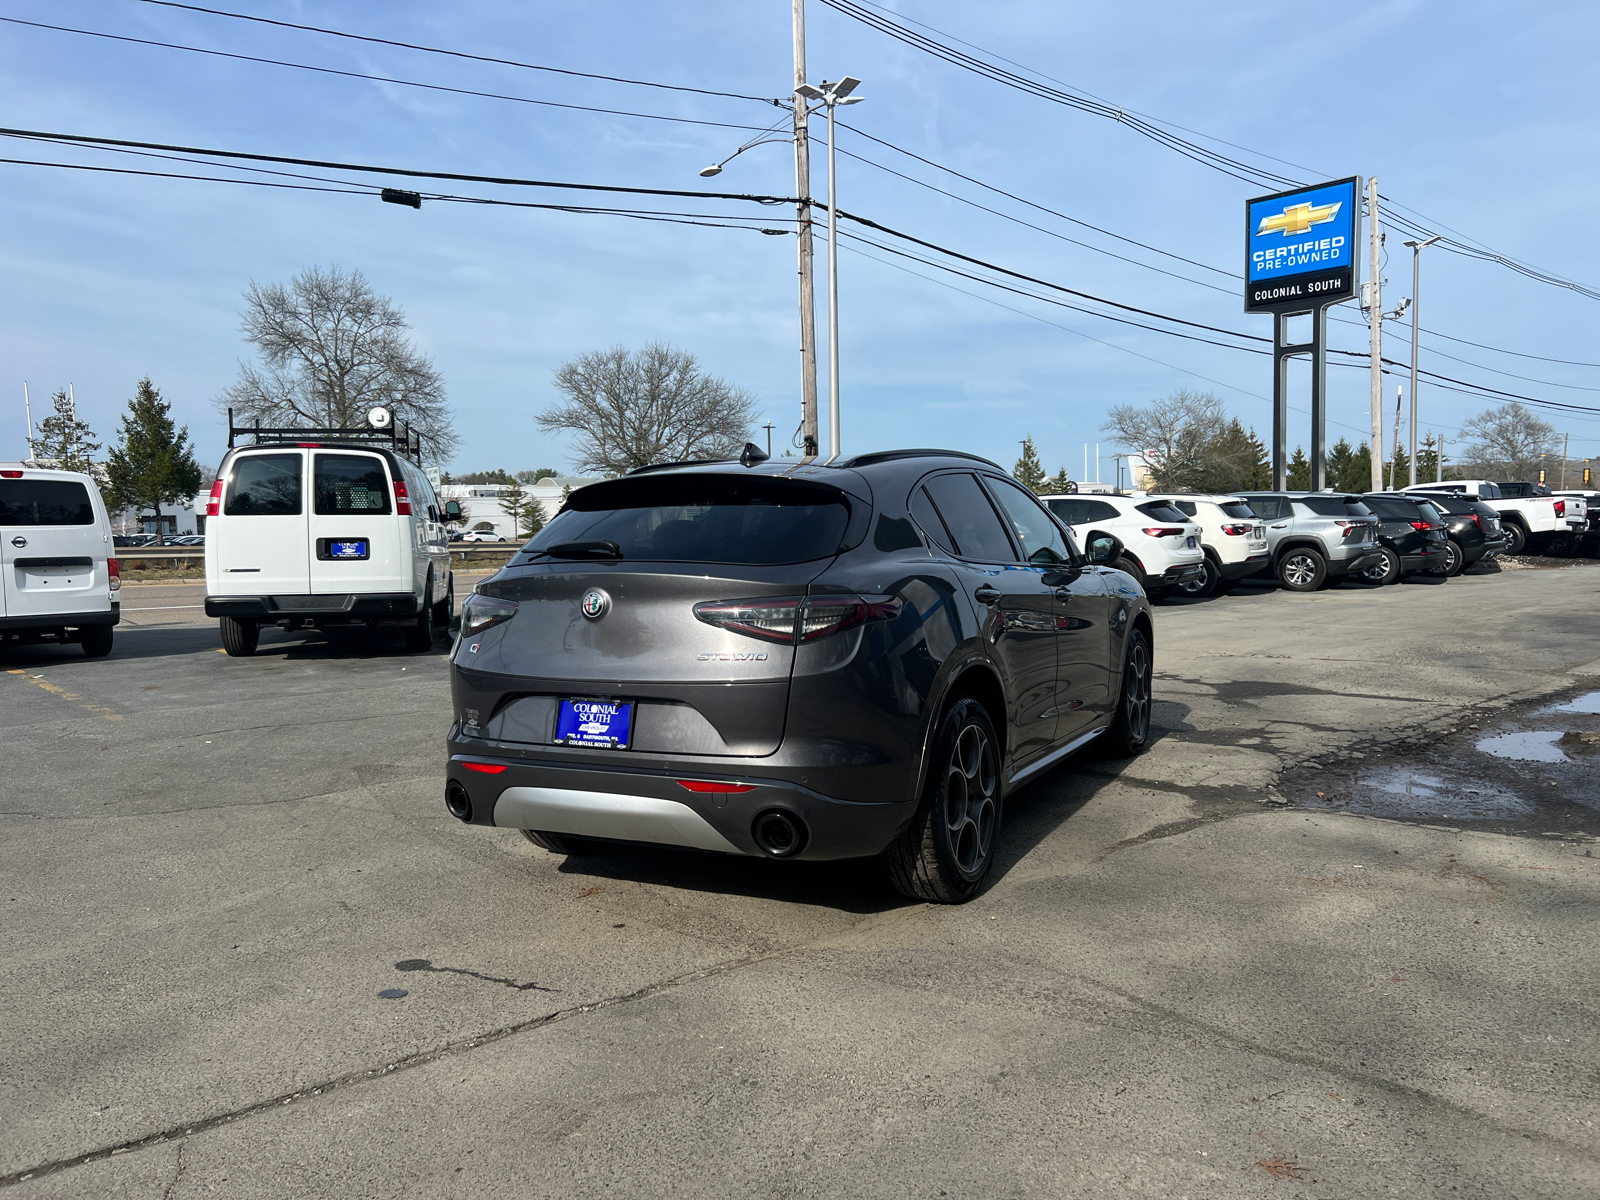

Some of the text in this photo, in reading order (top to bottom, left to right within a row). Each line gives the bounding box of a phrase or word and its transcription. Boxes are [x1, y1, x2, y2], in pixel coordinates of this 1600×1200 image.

[1253, 236, 1345, 262] CERTIFIED
[1257, 248, 1340, 271] PRE-OWNED
[1254, 279, 1341, 301] COLONIAL SOUTH
[696, 653, 768, 661] STELVIO
[573, 703, 619, 715] COLONIAL
[579, 713, 611, 723] SOUTH
[568, 739, 594, 747] COLONIAL
